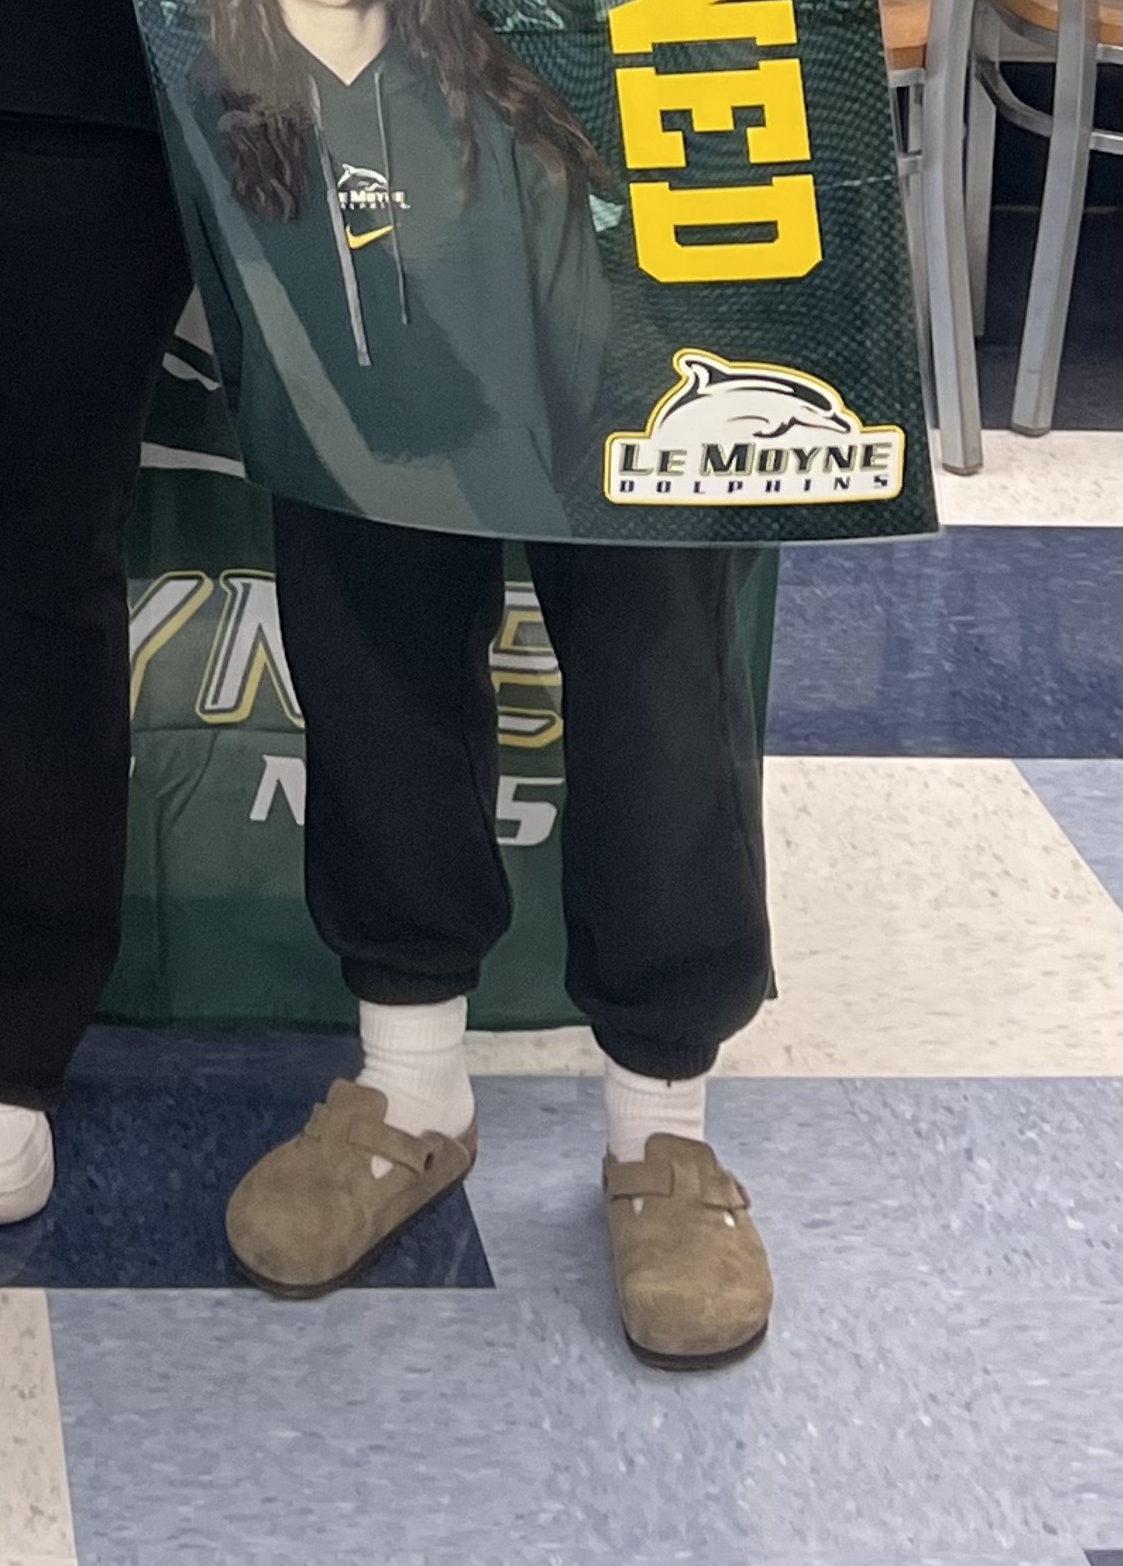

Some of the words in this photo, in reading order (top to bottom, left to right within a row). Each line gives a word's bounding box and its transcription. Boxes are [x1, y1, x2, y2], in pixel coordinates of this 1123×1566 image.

[618, 442, 688, 477] LE
[699, 441, 893, 477] MOYNE
[619, 474, 889, 494] DOLPHINS
